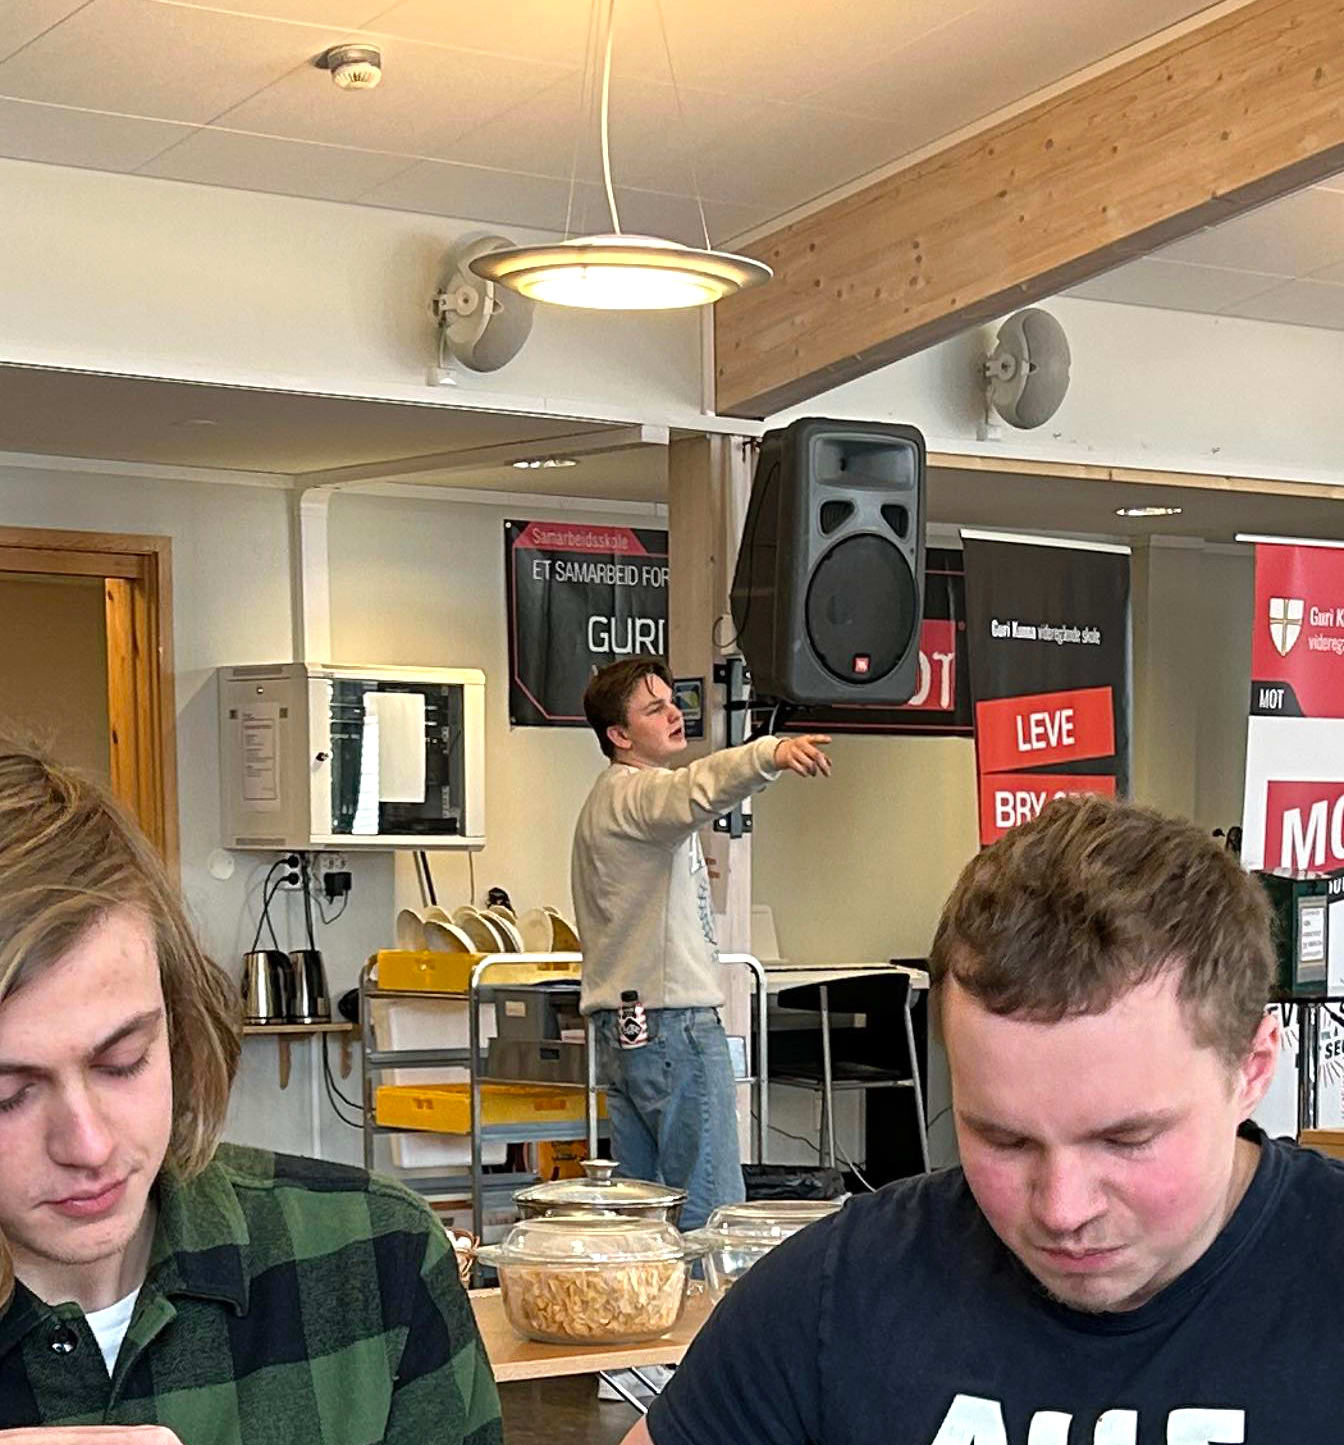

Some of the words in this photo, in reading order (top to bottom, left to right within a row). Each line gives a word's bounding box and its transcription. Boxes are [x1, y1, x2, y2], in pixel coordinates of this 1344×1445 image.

[532, 527, 629, 550] Samarbeidsskole
[533, 560, 553, 581] ET
[556, 561, 639, 587] SAMARBEID
[588, 616, 666, 656] GURI
[1258, 688, 1285, 710] MOT
[1016, 708, 1076, 752] LEVE
